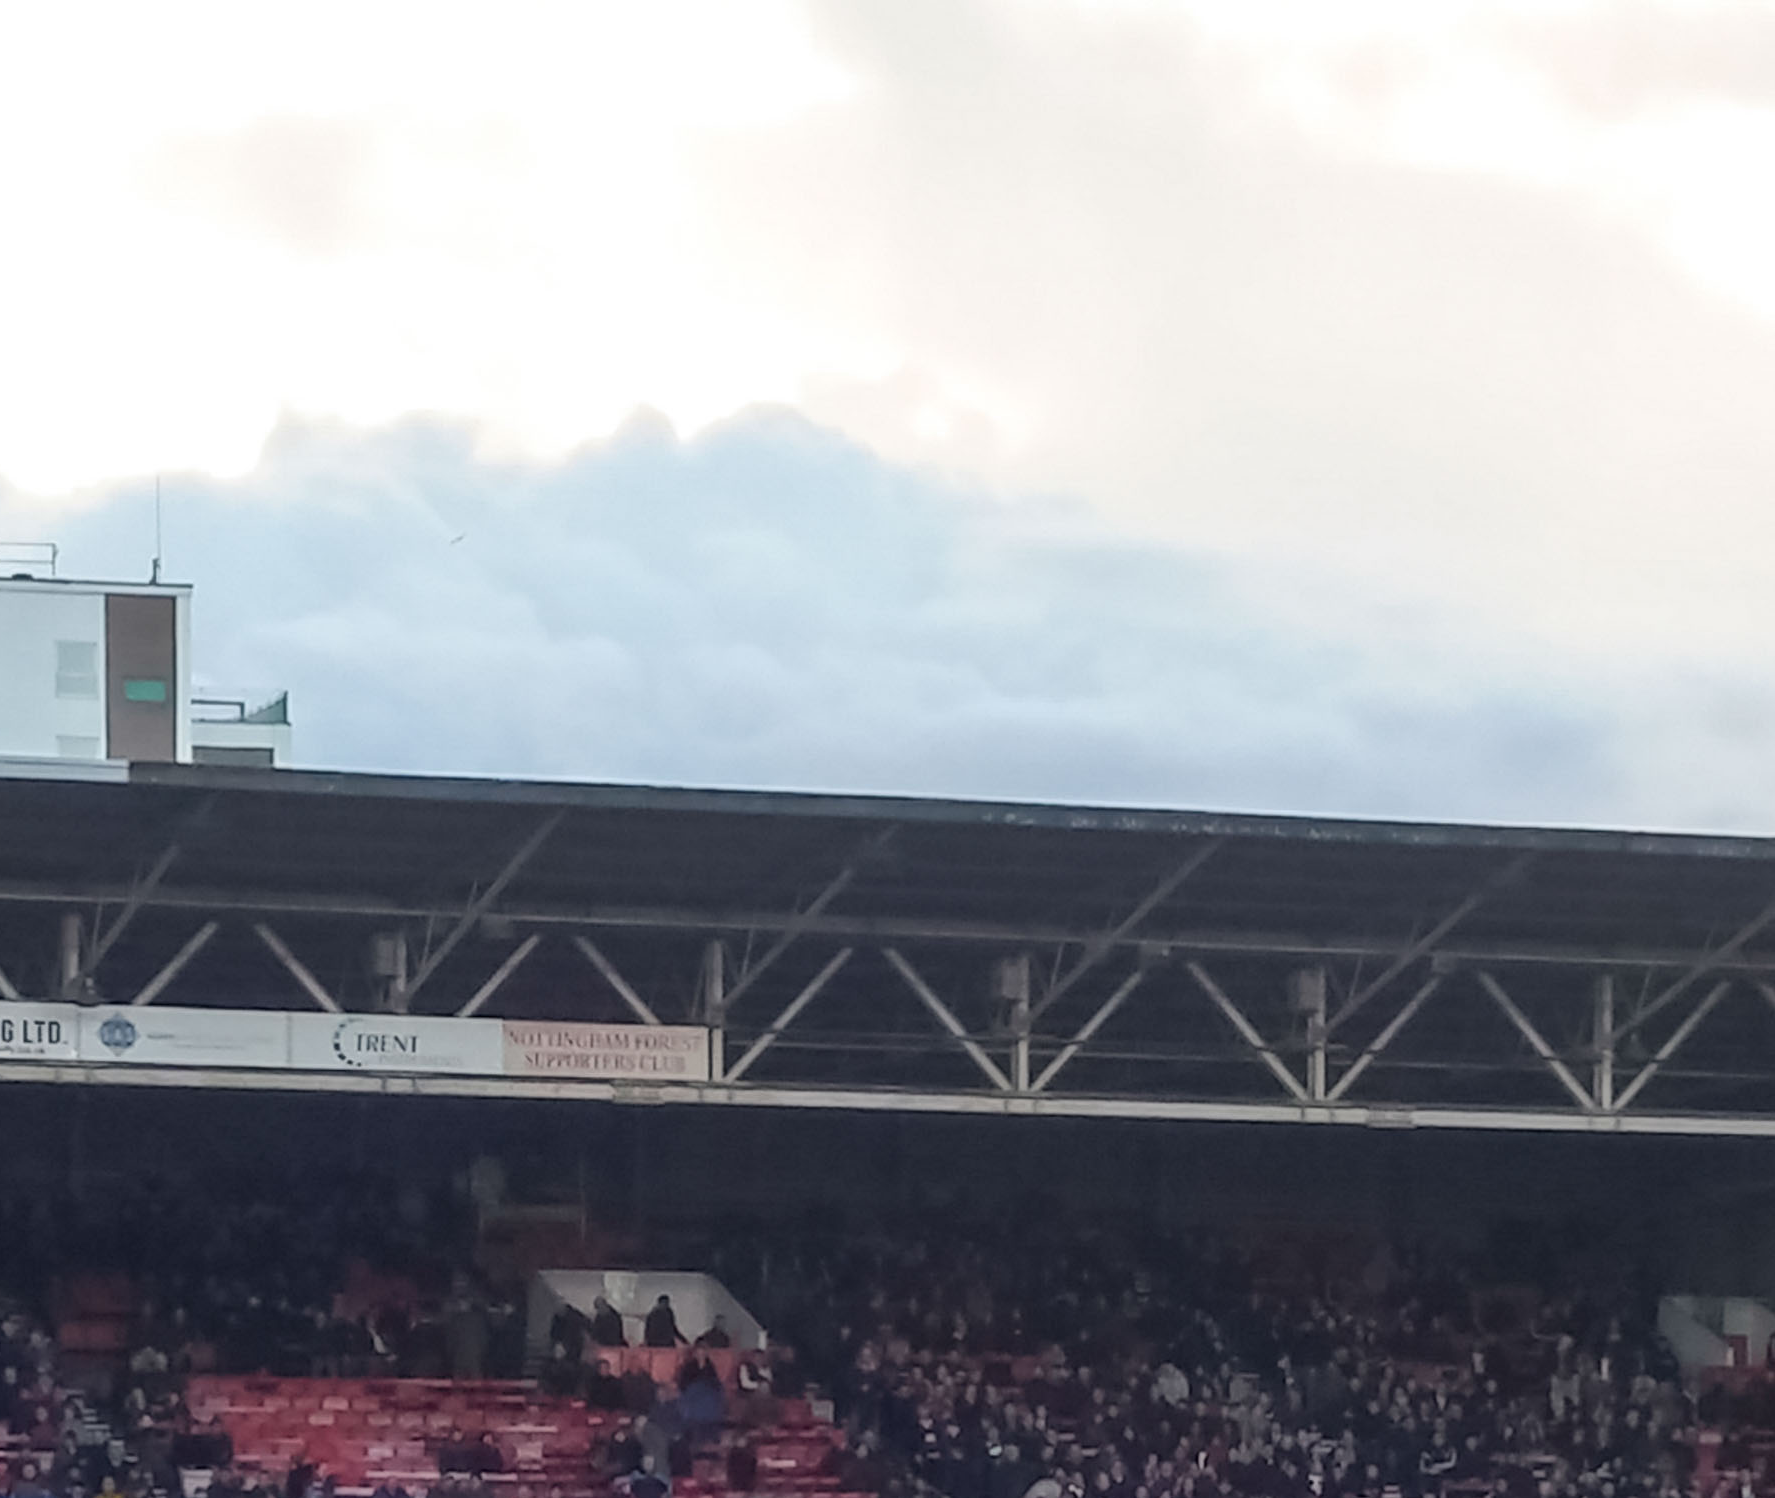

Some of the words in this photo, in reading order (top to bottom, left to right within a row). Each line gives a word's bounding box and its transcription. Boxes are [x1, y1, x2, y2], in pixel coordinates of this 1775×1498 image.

[356, 1033, 418, 1053] TRENT
[509, 1030, 630, 1050] NOTTINGHAM
[634, 1034, 704, 1051] FOREST
[524, 1052, 636, 1071] SUPPORTERS
[638, 1056, 686, 1072] CLUB
